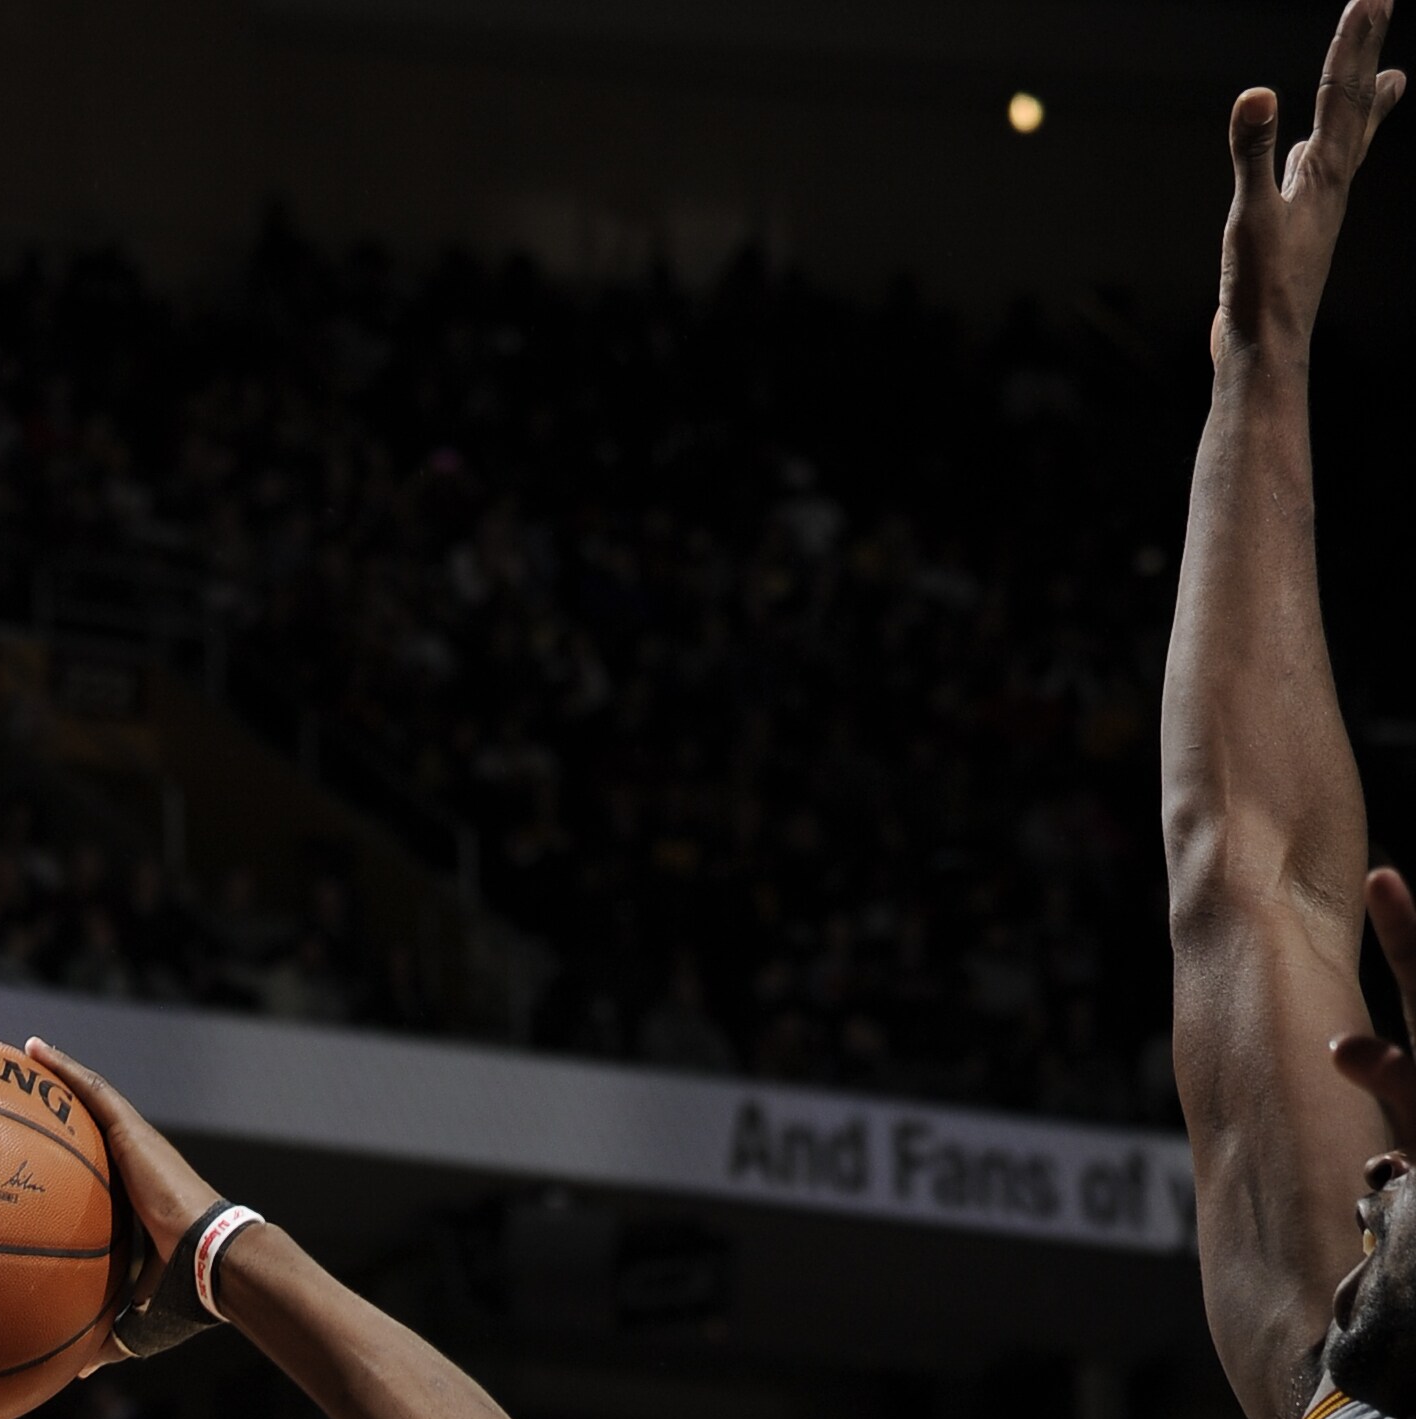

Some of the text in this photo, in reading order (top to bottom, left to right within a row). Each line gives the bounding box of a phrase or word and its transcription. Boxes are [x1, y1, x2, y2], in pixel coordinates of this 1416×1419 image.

[730, 1100, 869, 1194] And
[890, 1116, 1062, 1220] Fans
[1079, 1147, 1150, 1229] of
